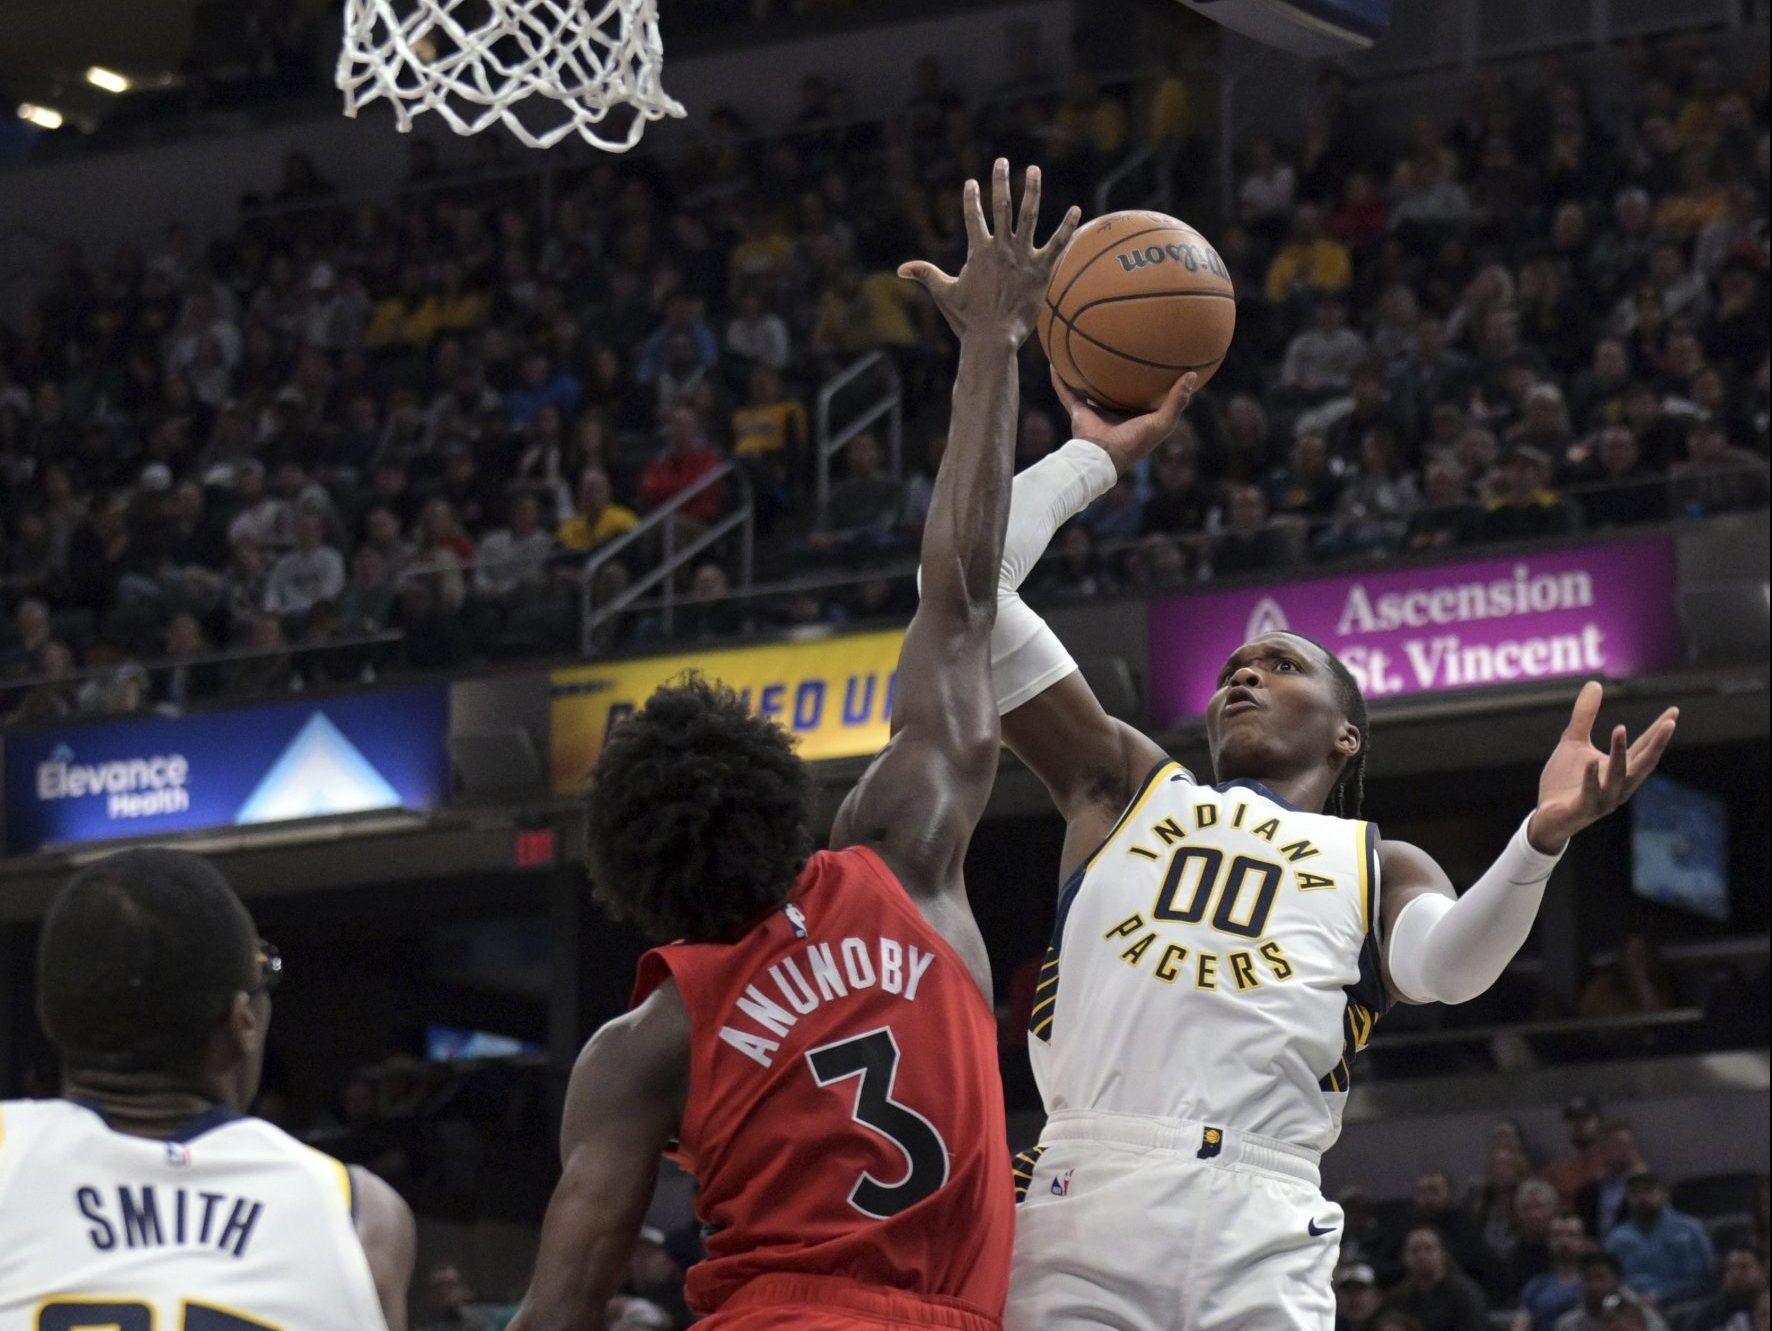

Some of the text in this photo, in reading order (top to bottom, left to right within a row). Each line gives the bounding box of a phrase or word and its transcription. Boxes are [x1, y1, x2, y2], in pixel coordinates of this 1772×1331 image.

[1117, 243, 1231, 279] Wilson
[1337, 562, 1594, 636] Ascension
[1338, 624, 1606, 694] St. Vincent
[36, 754, 188, 800] Elevance
[107, 786, 189, 819] Health
[1127, 802, 1336, 892] INDIANA
[1153, 846, 1283, 939] 00
[1103, 912, 1294, 992] PACERS
[718, 936, 935, 1069] ANUNOBY
[805, 1025, 950, 1221] 3
[76, 1185, 265, 1259] SMITH
